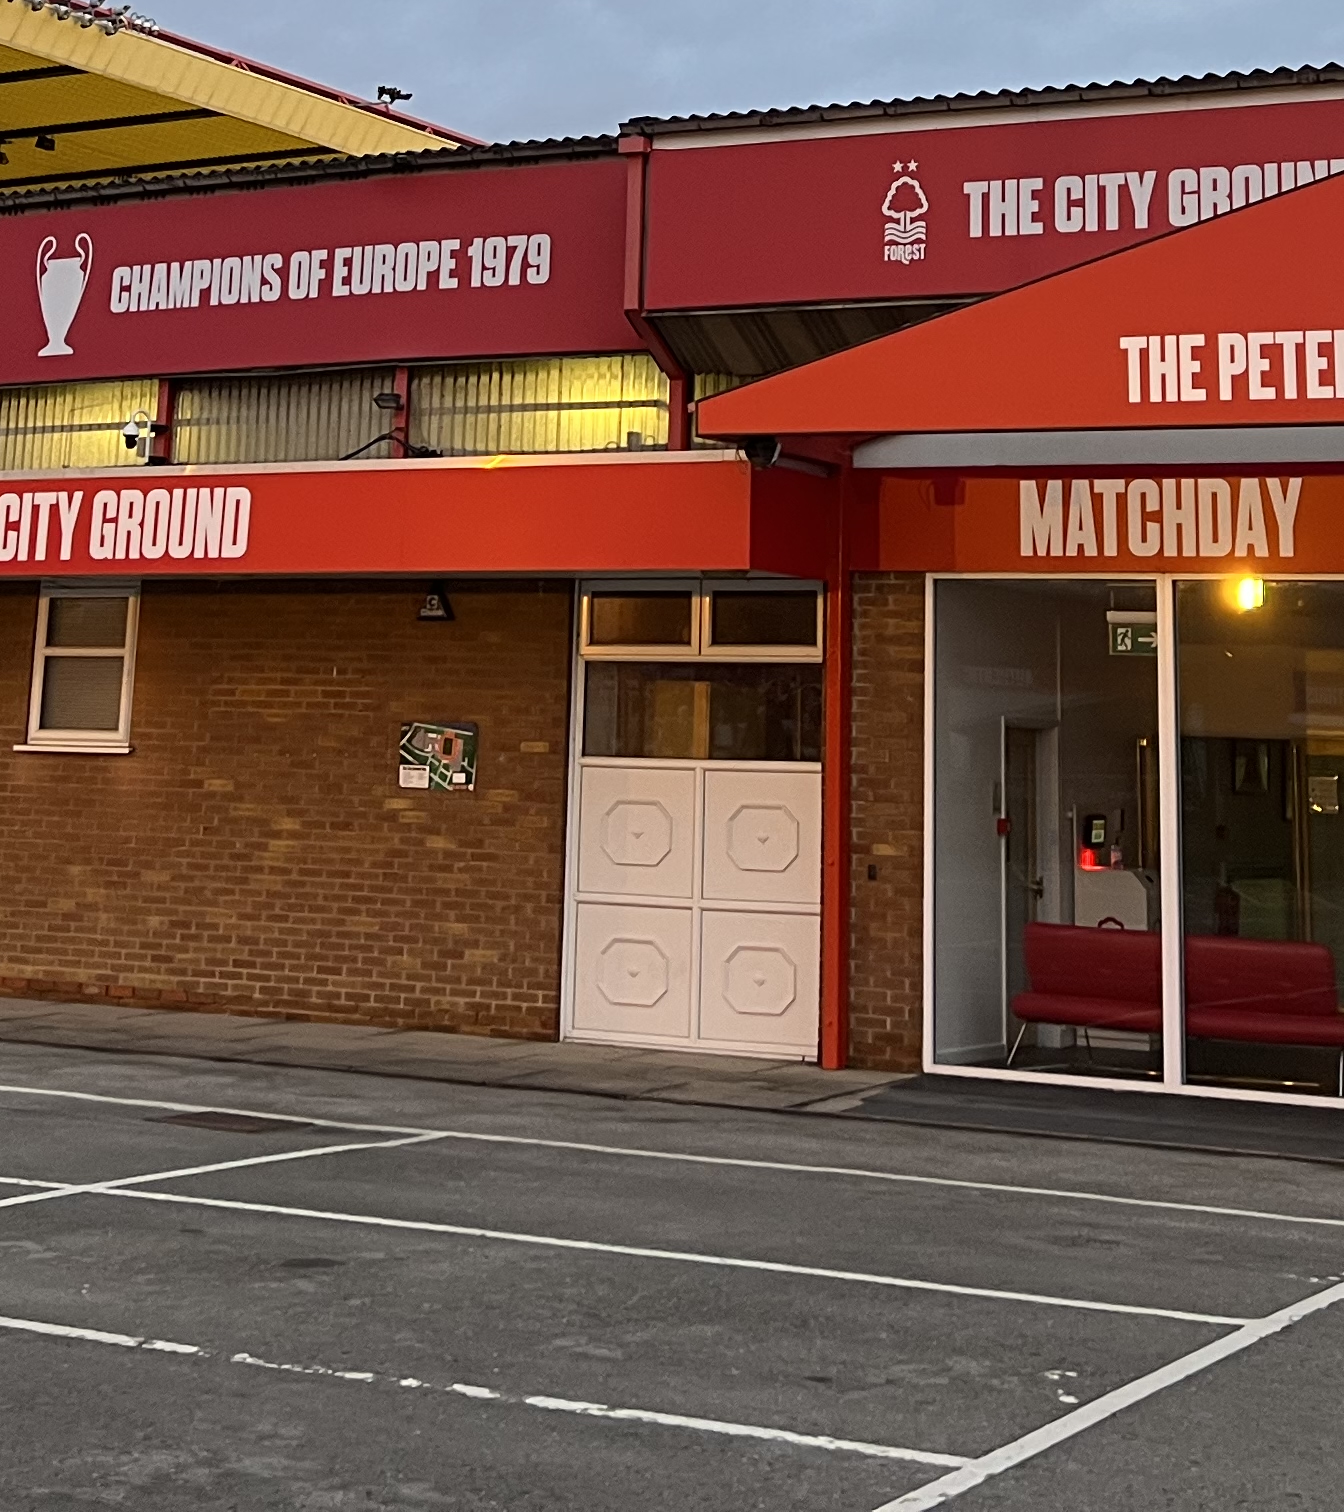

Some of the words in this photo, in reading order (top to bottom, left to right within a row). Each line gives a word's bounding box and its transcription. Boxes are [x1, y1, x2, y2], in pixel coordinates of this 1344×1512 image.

[964, 178, 1043, 237] THE
[1055, 171, 1156, 232] CITY
[110, 254, 282, 313] CHAMPIONS
[289, 250, 327, 299] OF
[332, 239, 460, 296] EUROPE
[468, 234, 550, 287] 1979
[1120, 334, 1206, 403] THE
[90, 487, 251, 559] GROUND
[1020, 477, 1302, 558] MATCHDAY
